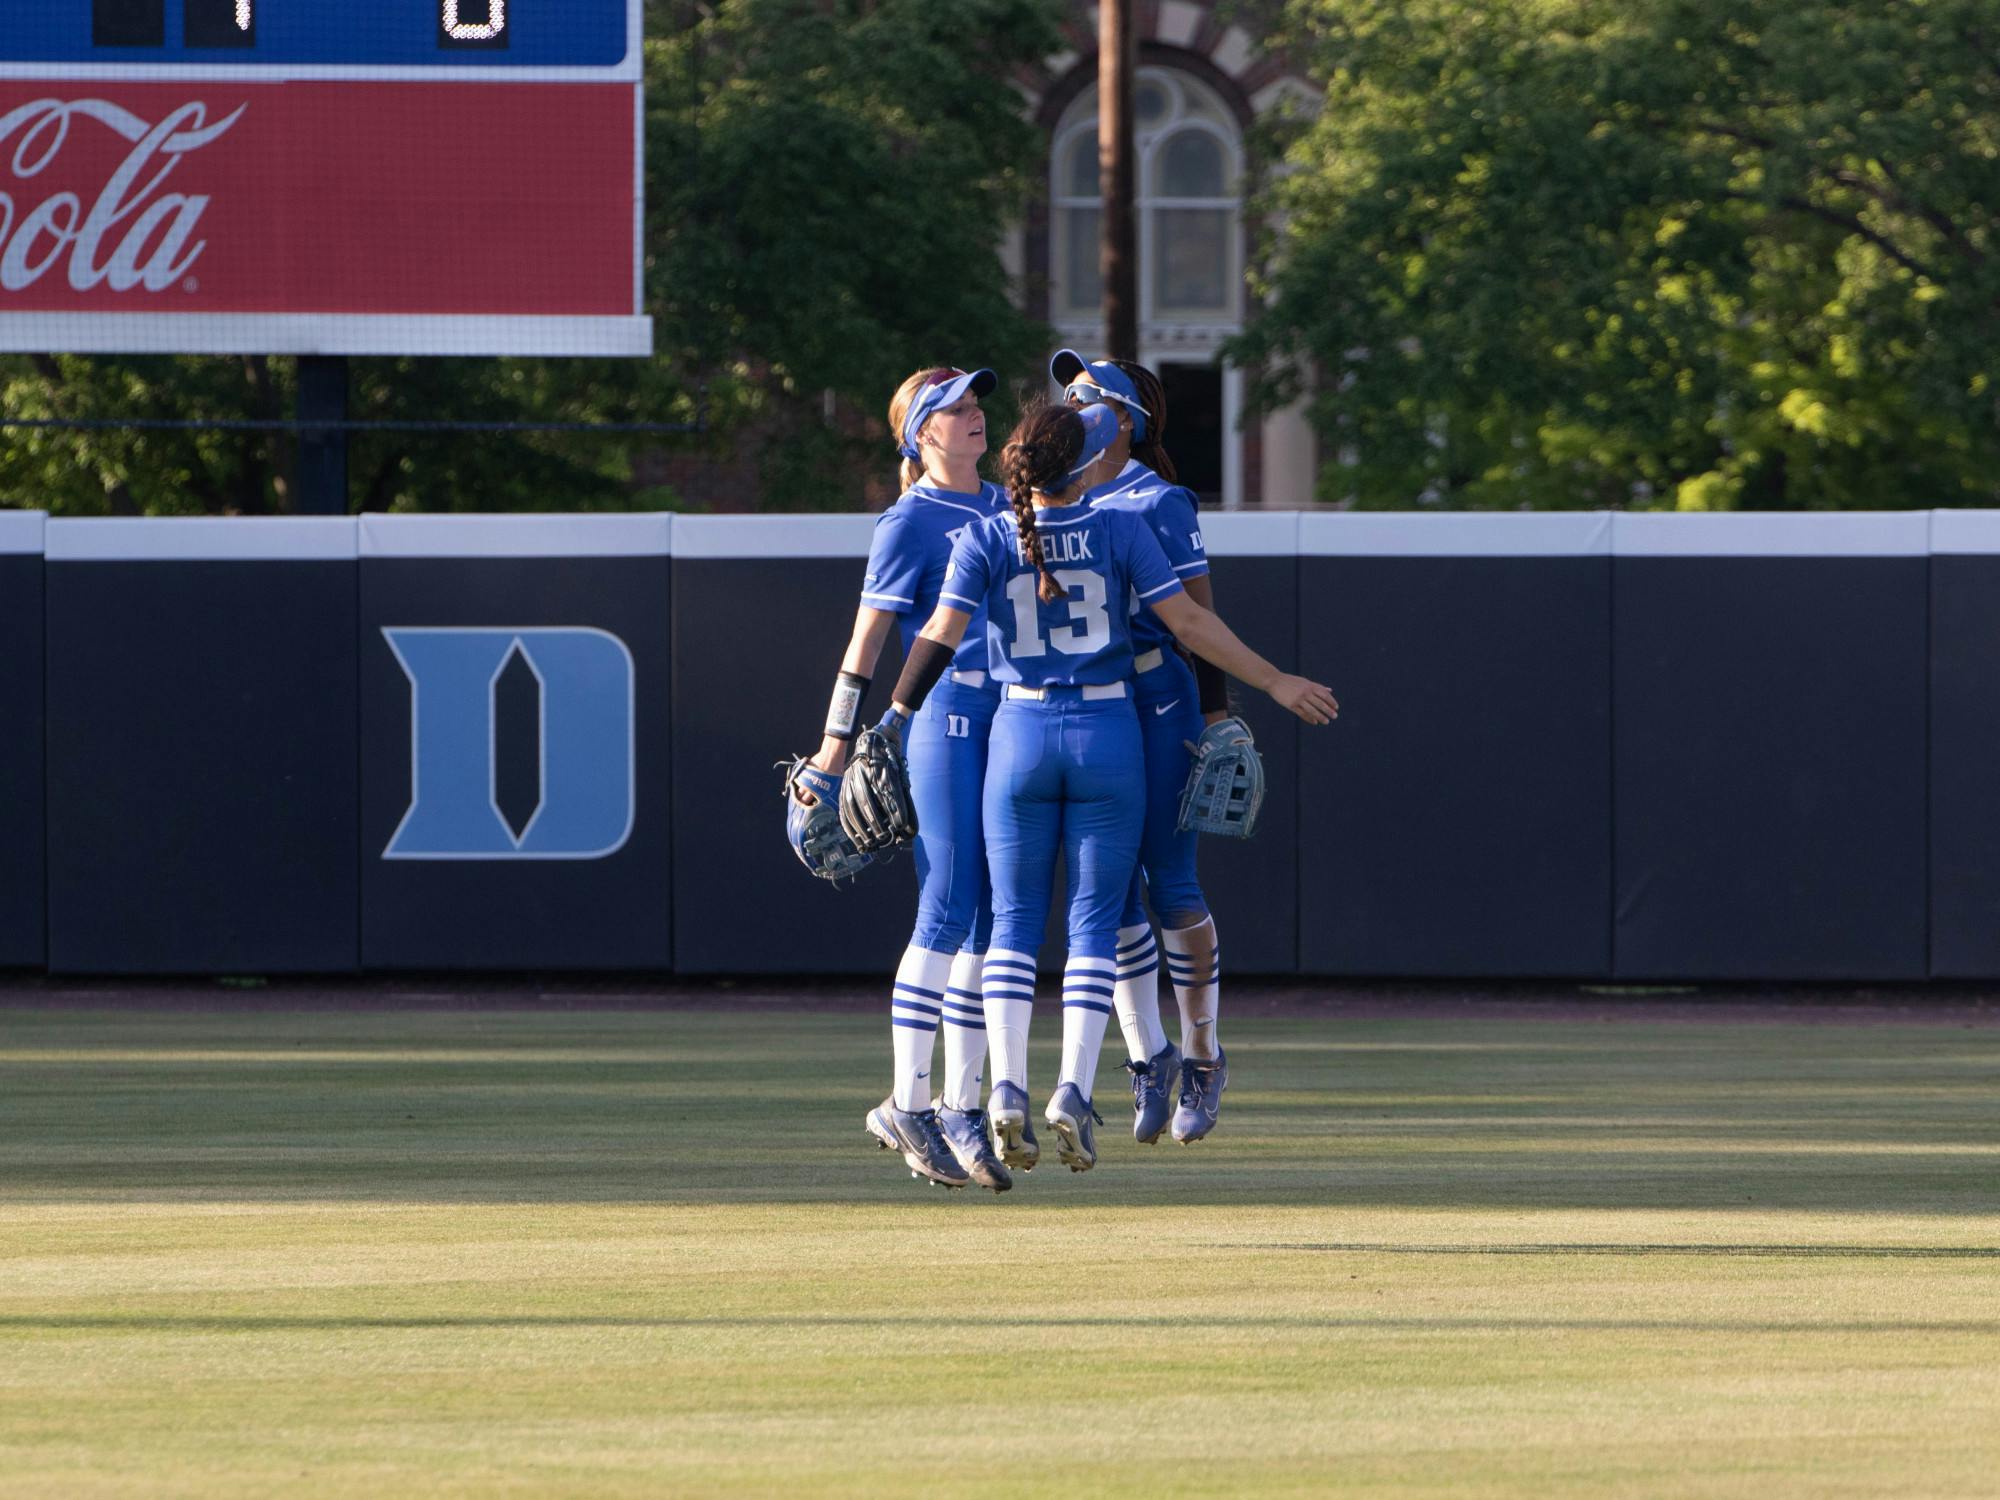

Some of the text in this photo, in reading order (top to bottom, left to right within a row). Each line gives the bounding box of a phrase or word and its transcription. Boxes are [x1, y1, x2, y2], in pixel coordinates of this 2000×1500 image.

[1016, 529, 1094, 567] FELICK
[1006, 569, 1110, 659] 13
[380, 625, 636, 860] D
[946, 713, 970, 738] D
